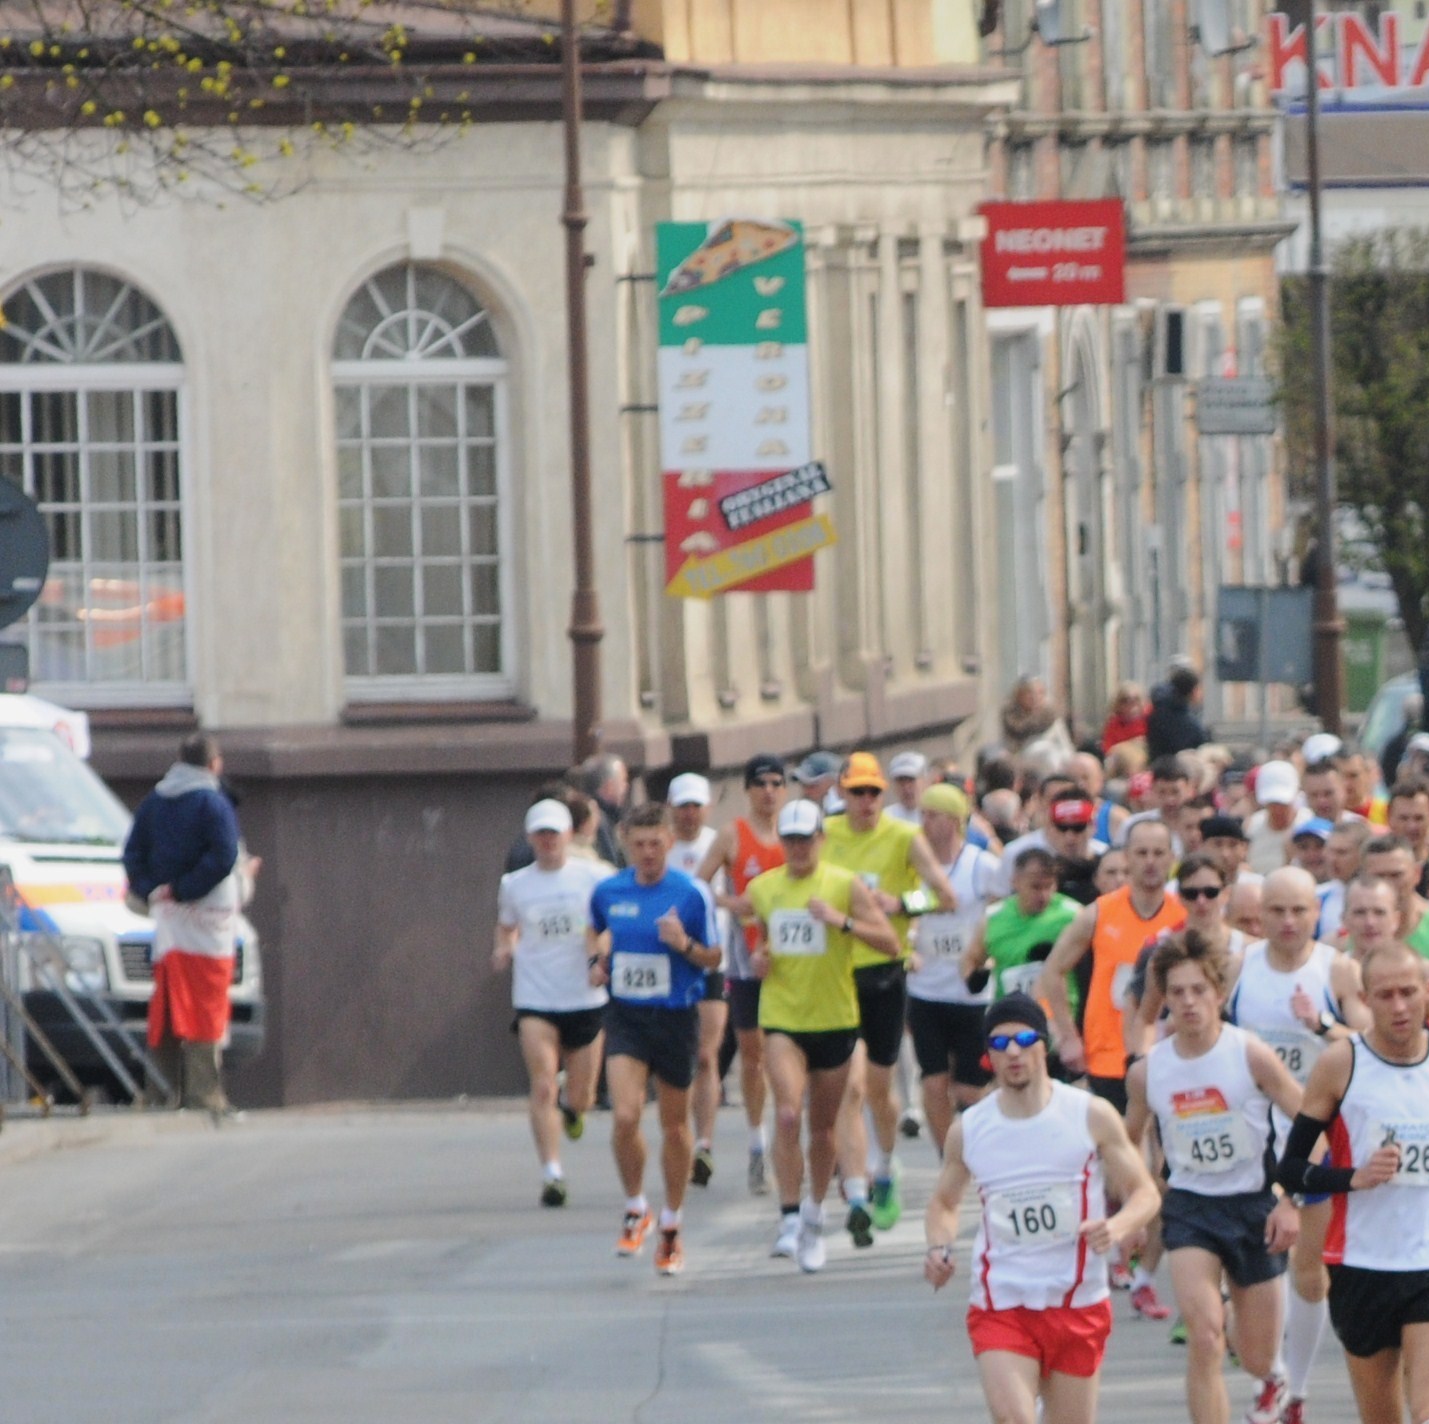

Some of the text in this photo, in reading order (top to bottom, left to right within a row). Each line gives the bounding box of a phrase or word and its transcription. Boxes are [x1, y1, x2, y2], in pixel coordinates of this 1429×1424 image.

[994, 227, 1108, 252] NEONET
[1190, 1134, 1235, 1164] 435
[1008, 1203, 1057, 1237] 160
